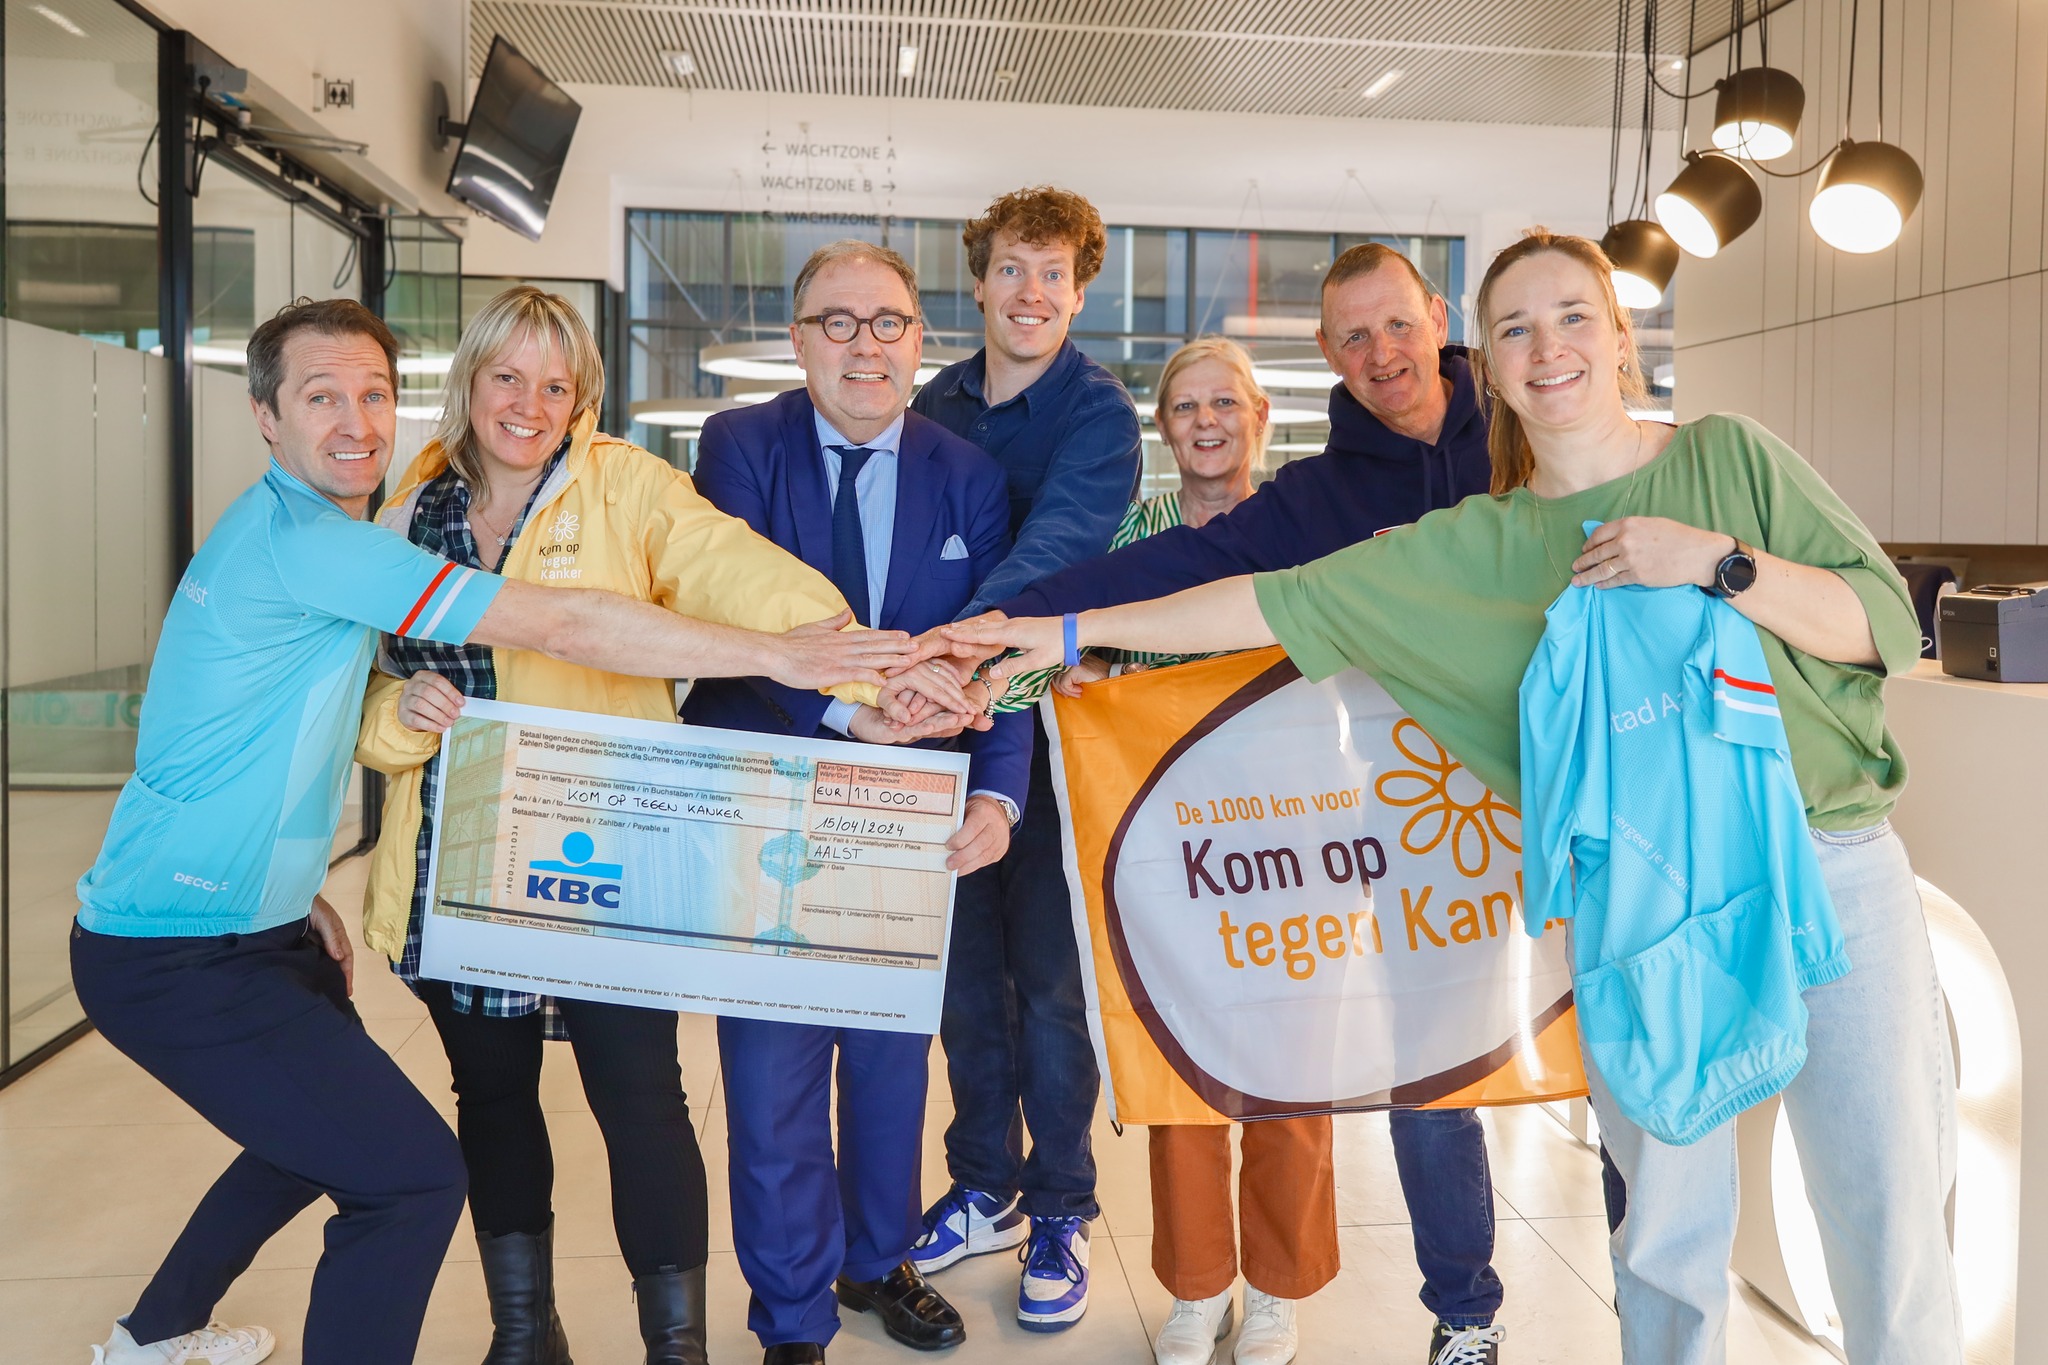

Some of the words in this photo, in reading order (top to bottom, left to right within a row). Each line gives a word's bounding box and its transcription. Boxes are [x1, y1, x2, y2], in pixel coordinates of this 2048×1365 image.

[785, 144, 881, 160] WACHTZONE
[887, 148, 896, 159] A
[761, 176, 856, 192] WACHTZONE
[863, 179, 873, 192] B
[785, 211, 881, 226] WACHTZONE
[539, 543, 562, 556] Kom
[566, 543, 580, 554] op
[542, 555, 576, 568] tegen
[540, 567, 583, 581] Kanker
[183, 575, 208, 607] Aalst
[1610, 697, 1656, 735] tad
[518, 738, 542, 747] Zahlen
[543, 741, 555, 749] Sie
[555, 744, 579, 753] gegen
[579, 745, 602, 755] diesen
[603, 748, 629, 758] Scheck
[630, 751, 641, 759] die
[642, 753, 670, 763] Summe
[689, 759, 702, 768] Pay
[704, 760, 730, 771] against
[731, 763, 744, 771] this
[745, 765, 772, 775] cheque
[519, 730, 541, 739] Betaal
[542, 733, 561, 743] tegen
[562, 735, 579, 744] deze
[580, 737, 607, 749] cheque
[651, 746, 673, 756] Payez
[674, 748, 697, 757] contre
[707, 752, 734, 763] chèque
[742, 757, 768, 765] somme
[515, 770, 540, 780] bedrag
[549, 774, 572, 783] letters
[589, 780, 611, 788] toutes
[612, 782, 635, 791] lettres
[651, 787, 693, 797] Buchstaben
[709, 793, 731, 802] letters
[816, 785, 842, 797] EUR
[567, 788, 600, 803] KOM
[607, 792, 626, 807] OP
[632, 797, 678, 812] TEGEN
[687, 803, 744, 820] KANKER
[1174, 800, 1204, 826] De
[1210, 795, 1265, 825] 1000
[1270, 793, 1306, 818] km
[1313, 785, 1361, 811] voor
[511, 807, 549, 818] Betaalbaar
[556, 813, 584, 824] Payable
[598, 818, 625, 827] Zahlbar
[632, 822, 660, 833] Payable
[814, 815, 904, 837] 15/04/2024
[813, 843, 862, 861] AALST
[854, 838, 898, 849] Ausstellungsort
[1611, 811, 1653, 853] vergeet
[1647, 848, 1664, 864] je
[1662, 863, 1690, 895] nooi
[1182, 837, 1304, 899] Kom
[1321, 835, 1389, 899] op
[526, 874, 621, 909] KBC
[801, 906, 841, 916] Handtekening
[847, 910, 880, 919] Unterschrift
[886, 913, 913, 923] Signature
[1218, 908, 1386, 981] tegen
[1400, 870, 1566, 951] Kan
